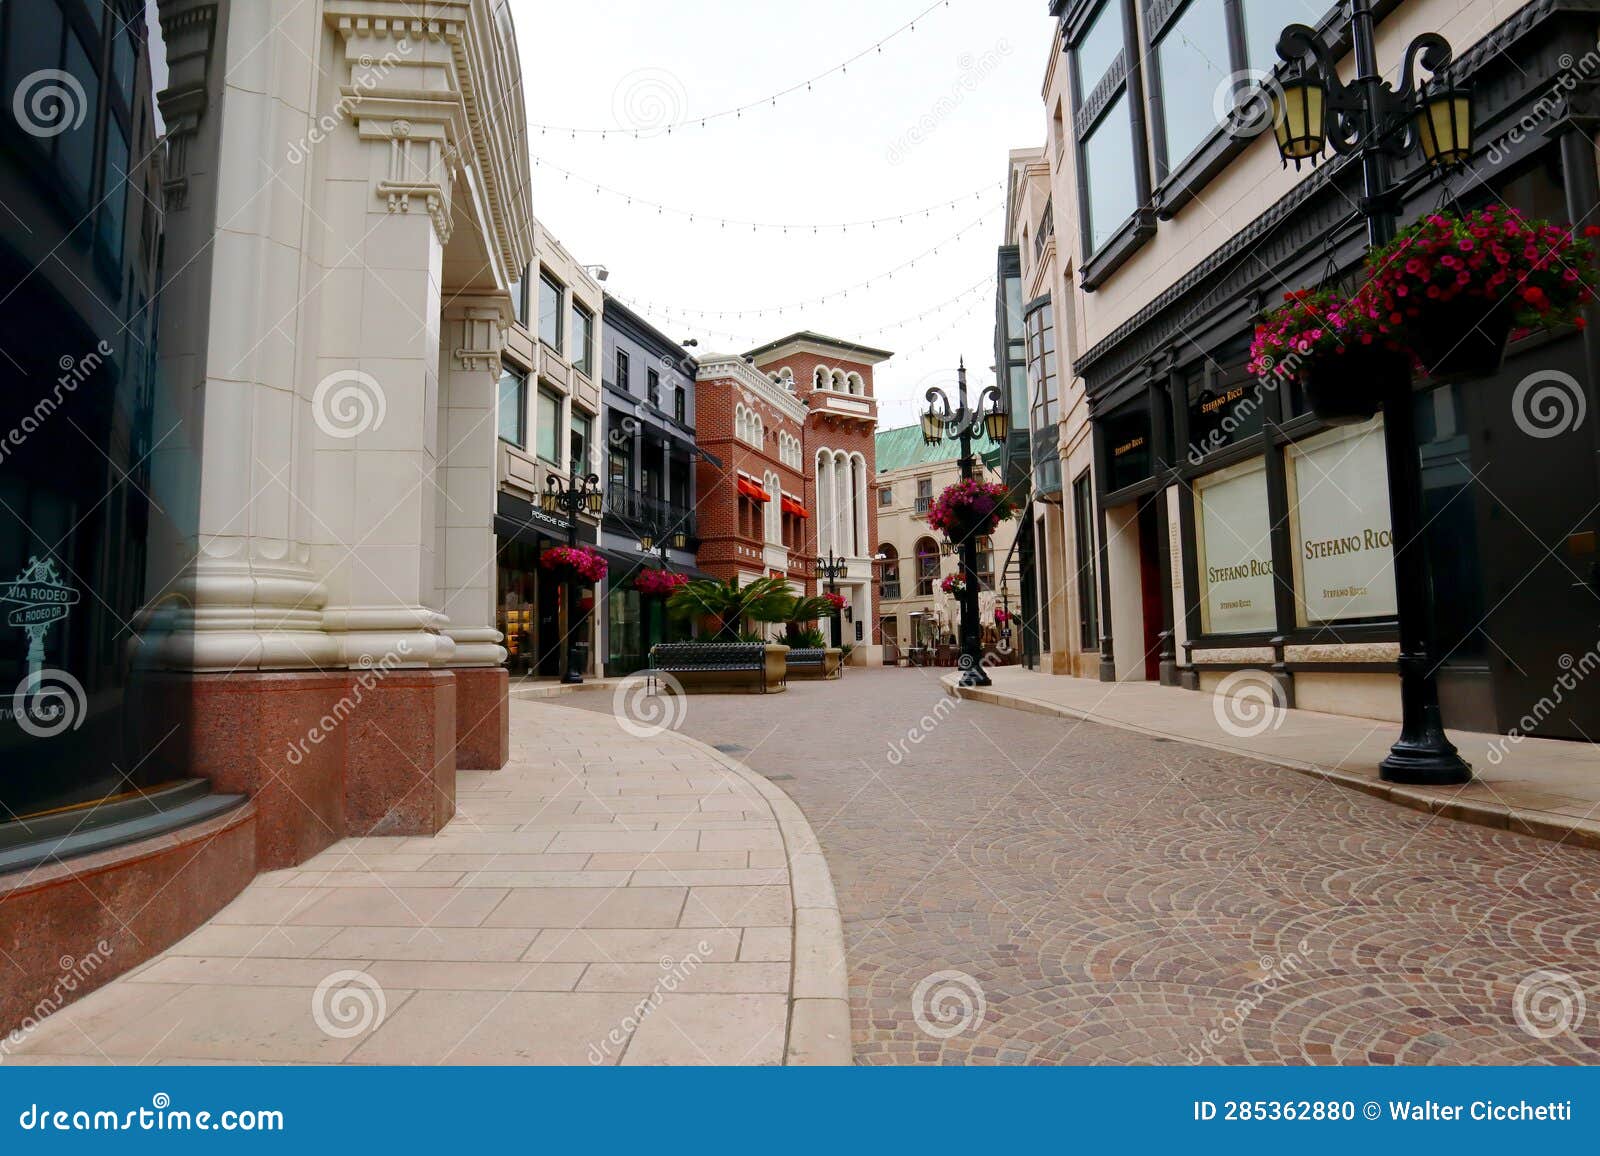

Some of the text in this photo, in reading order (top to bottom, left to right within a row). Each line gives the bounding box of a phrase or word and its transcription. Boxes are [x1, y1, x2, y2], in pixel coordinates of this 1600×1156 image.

[1202, 387, 1243, 413] STEFANO RICCI
[532, 510, 557, 525] PORSCHE
[1304, 529, 1393, 559] STEFANO RIC
[1208, 559, 1273, 583] STEFANO RICC
[8, 586, 68, 601] VIA RODEO
[16, 606, 62, 623] N. RODEO DR
